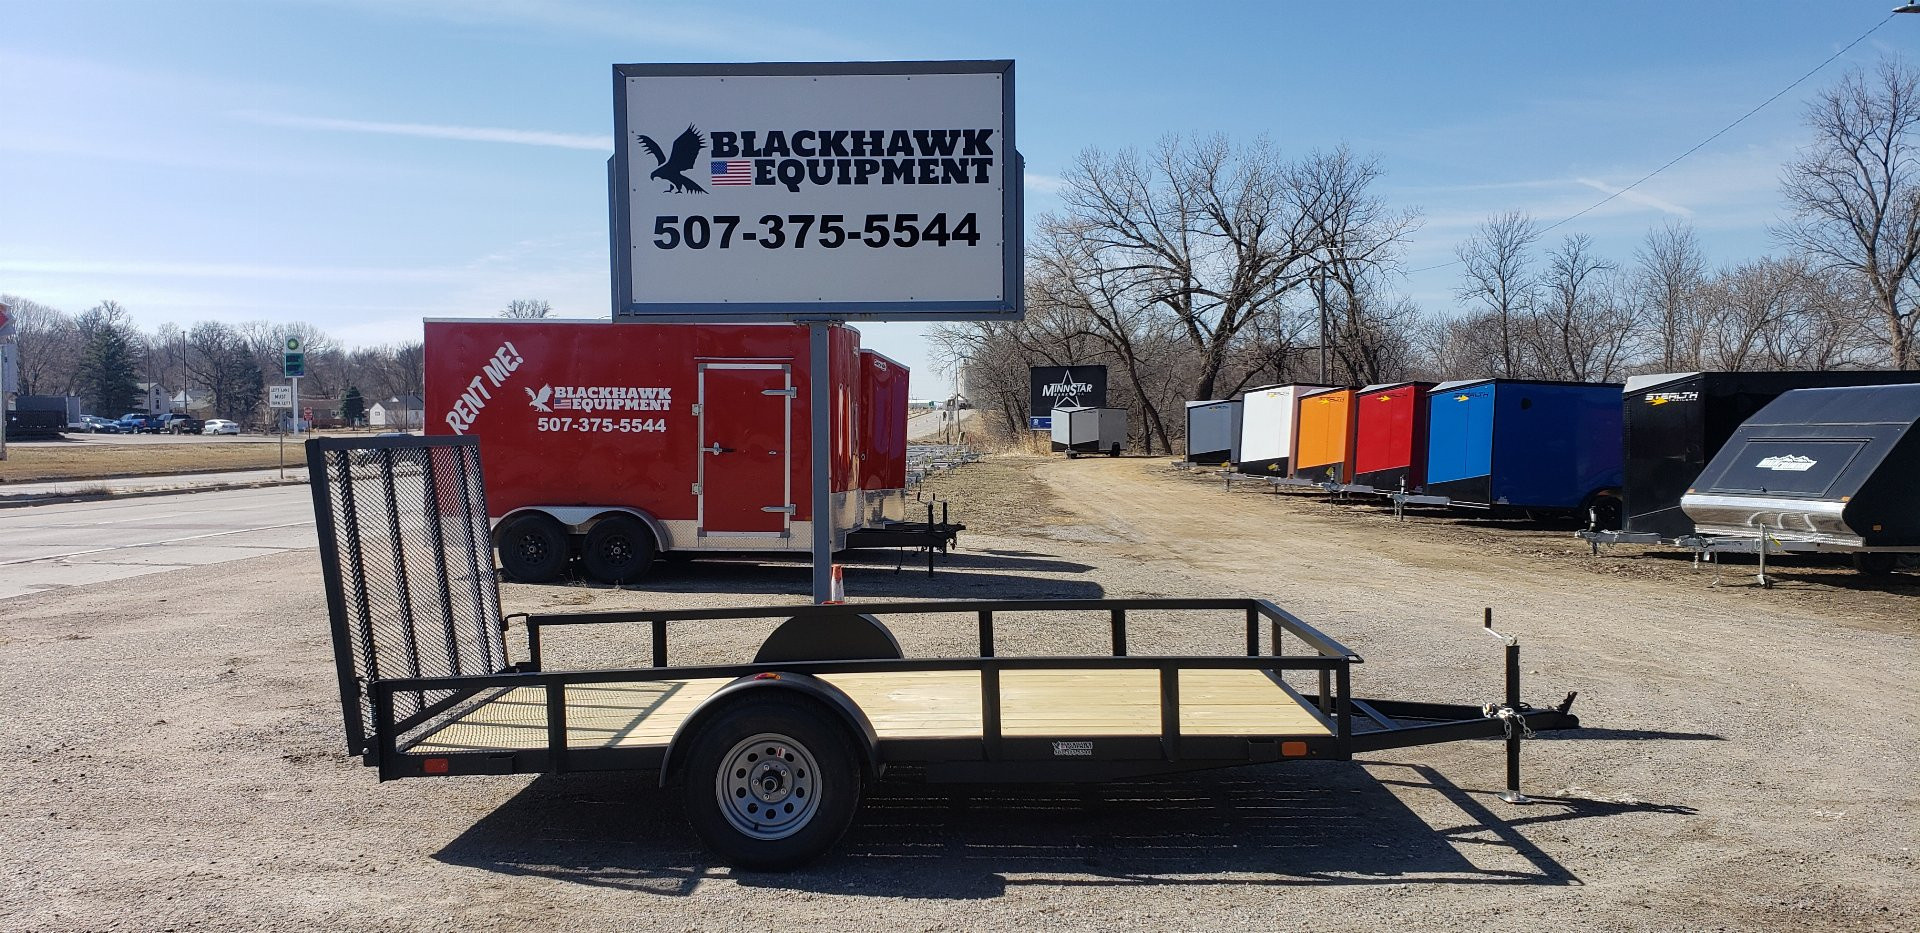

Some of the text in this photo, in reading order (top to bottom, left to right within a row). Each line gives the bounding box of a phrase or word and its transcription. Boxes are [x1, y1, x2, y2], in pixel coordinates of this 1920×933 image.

[711, 129, 994, 158] BLACKHAWK
[754, 157, 994, 193] EQUIPMENT
[653, 212, 981, 250] 507-375-5544
[445, 341, 524, 436] RENT ME!
[554, 386, 672, 400] BLACKHAWK
[1645, 392, 1699, 400] STEALTH
[571, 398, 672, 413] EQUIPMENT
[537, 417, 667, 433] 507-375-5544
